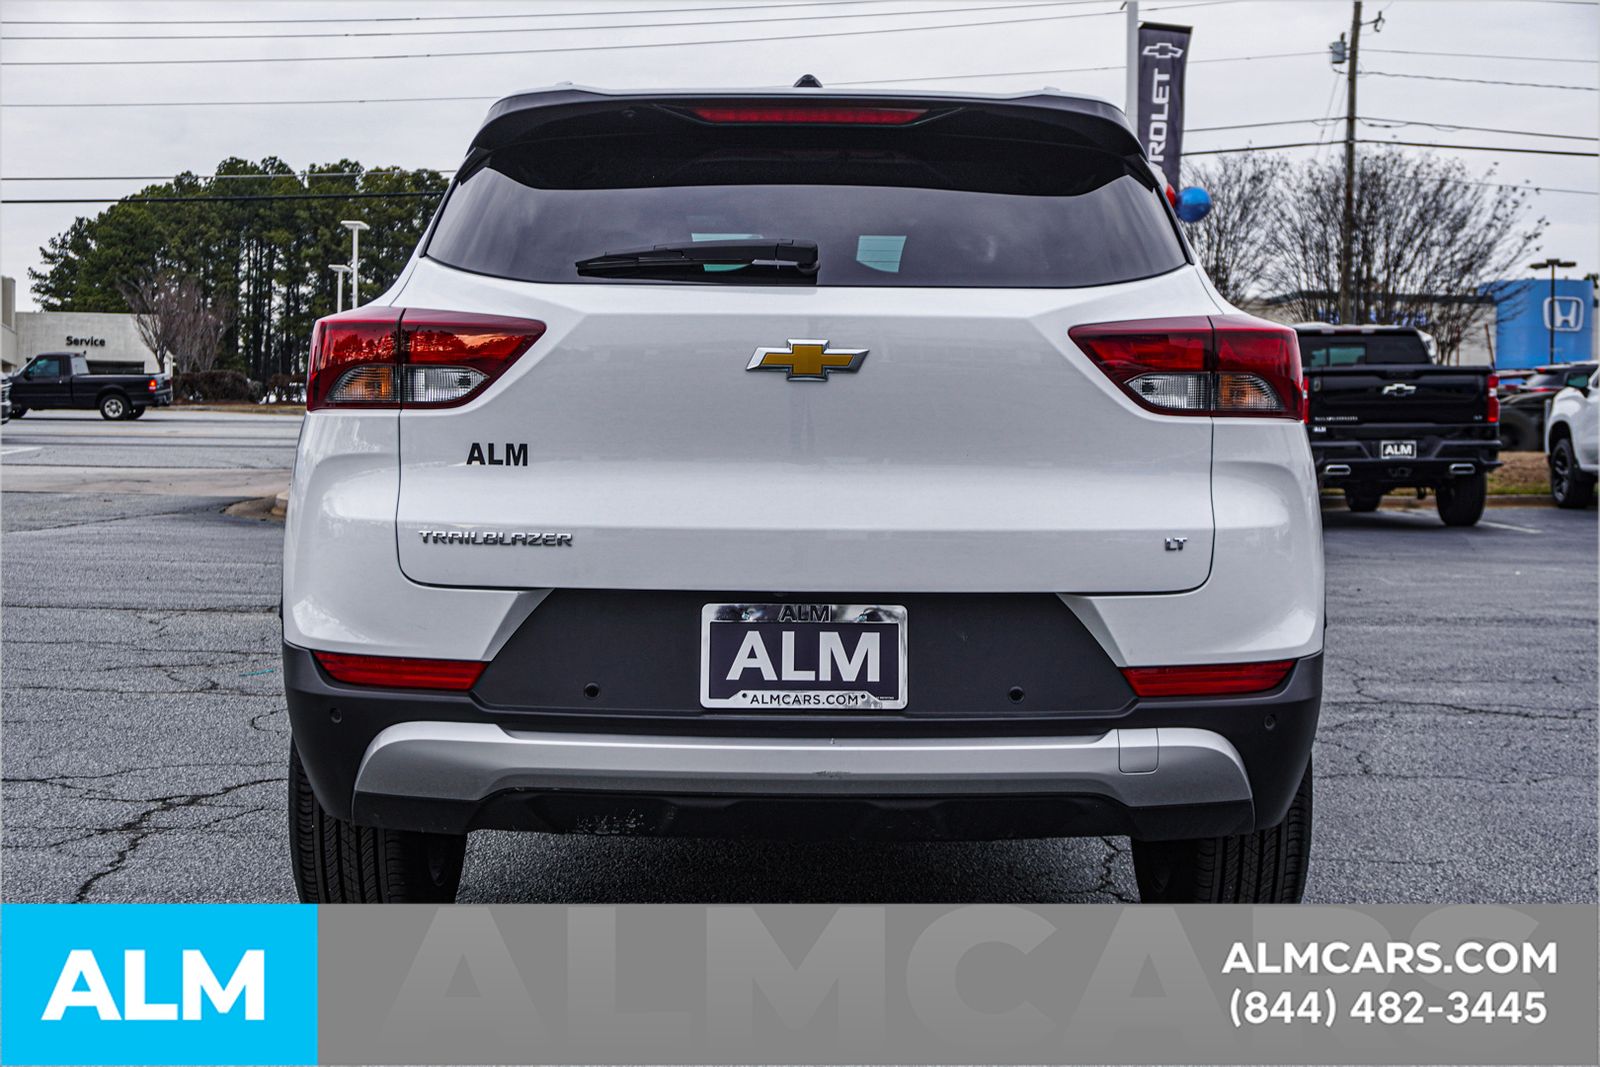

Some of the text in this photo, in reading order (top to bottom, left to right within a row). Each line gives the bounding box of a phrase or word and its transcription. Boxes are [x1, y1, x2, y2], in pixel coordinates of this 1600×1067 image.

[66, 335, 106, 347] Service
[466, 442, 529, 466] ALM
[1384, 444, 1413, 456] ALM
[418, 530, 573, 547] TRAILBLAZER
[1164, 537, 1188, 551] LT
[779, 605, 832, 622] ALM
[726, 631, 880, 682] ALM
[750, 694, 859, 706] ALMCARS.COM
